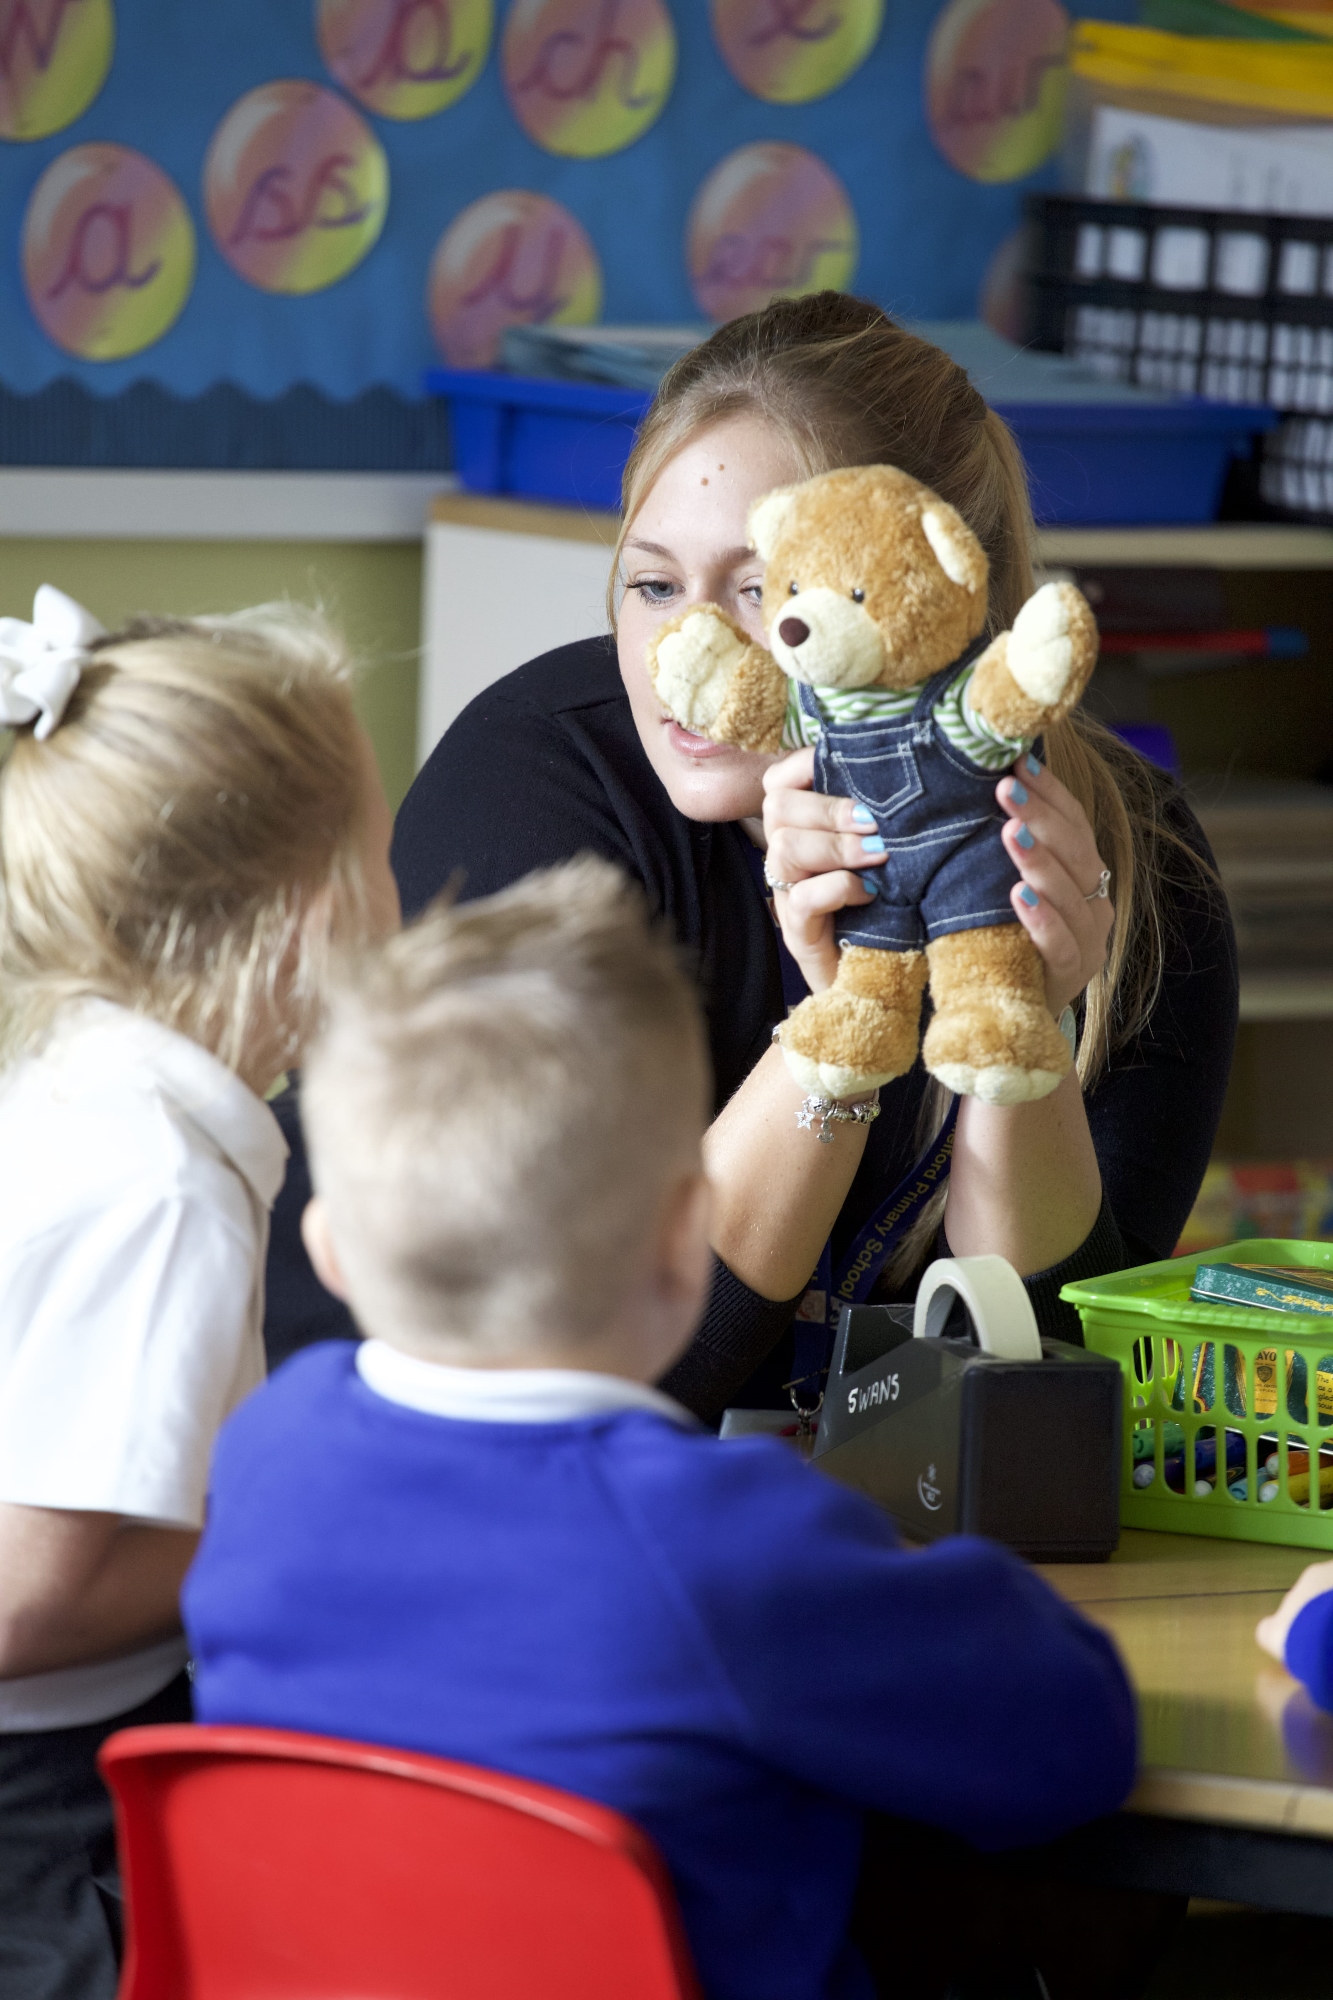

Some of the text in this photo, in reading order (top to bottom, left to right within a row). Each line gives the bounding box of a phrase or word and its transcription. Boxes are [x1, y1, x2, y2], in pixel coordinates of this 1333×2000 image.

[227, 152, 374, 248] ss
[46, 202, 164, 301] a
[875, 1180, 930, 1237] Primary
[837, 1238, 884, 1299] School
[847, 1373, 899, 1413] SWANS
